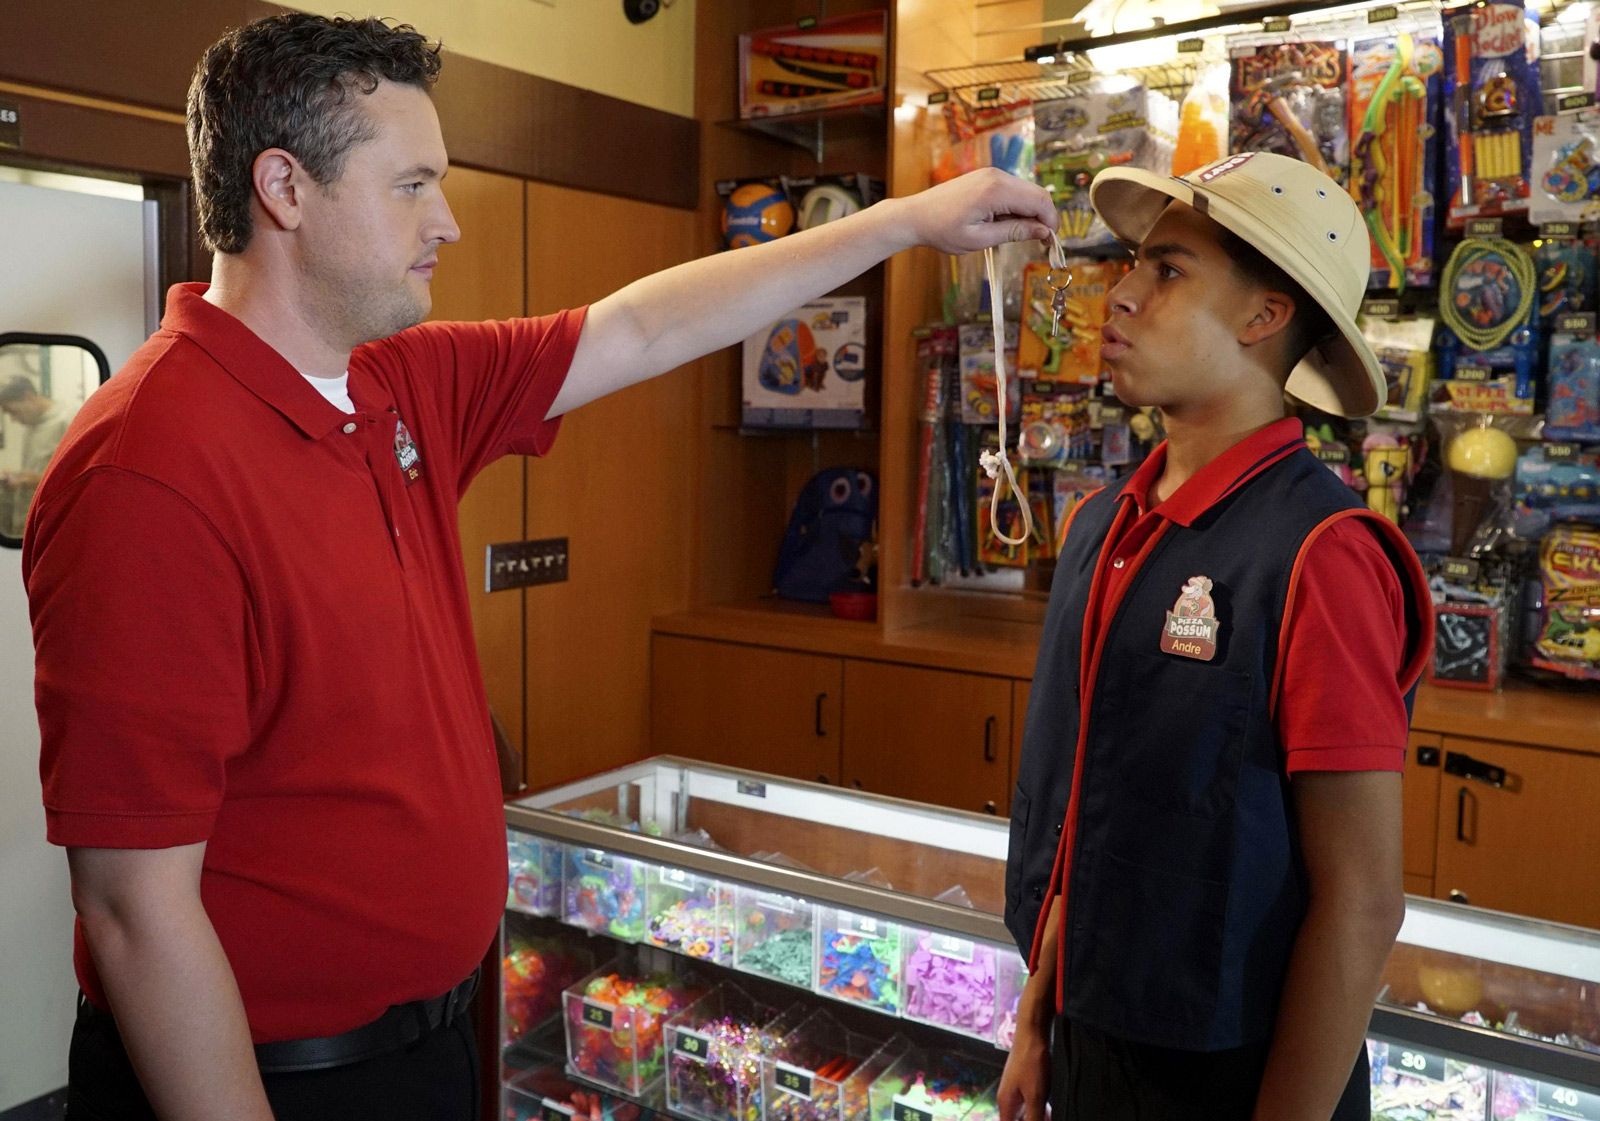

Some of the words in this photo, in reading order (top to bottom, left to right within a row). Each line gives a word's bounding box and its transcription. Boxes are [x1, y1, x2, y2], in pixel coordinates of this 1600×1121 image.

[1177, 617, 1204, 626] PIZZA
[1170, 621, 1211, 639] POSSUM
[1171, 639, 1202, 655] Andre
[683, 1038, 699, 1052] 30
[1400, 1050, 1427, 1071] 30
[783, 1073, 800, 1088] 35
[1551, 1087, 1579, 1107] 40
